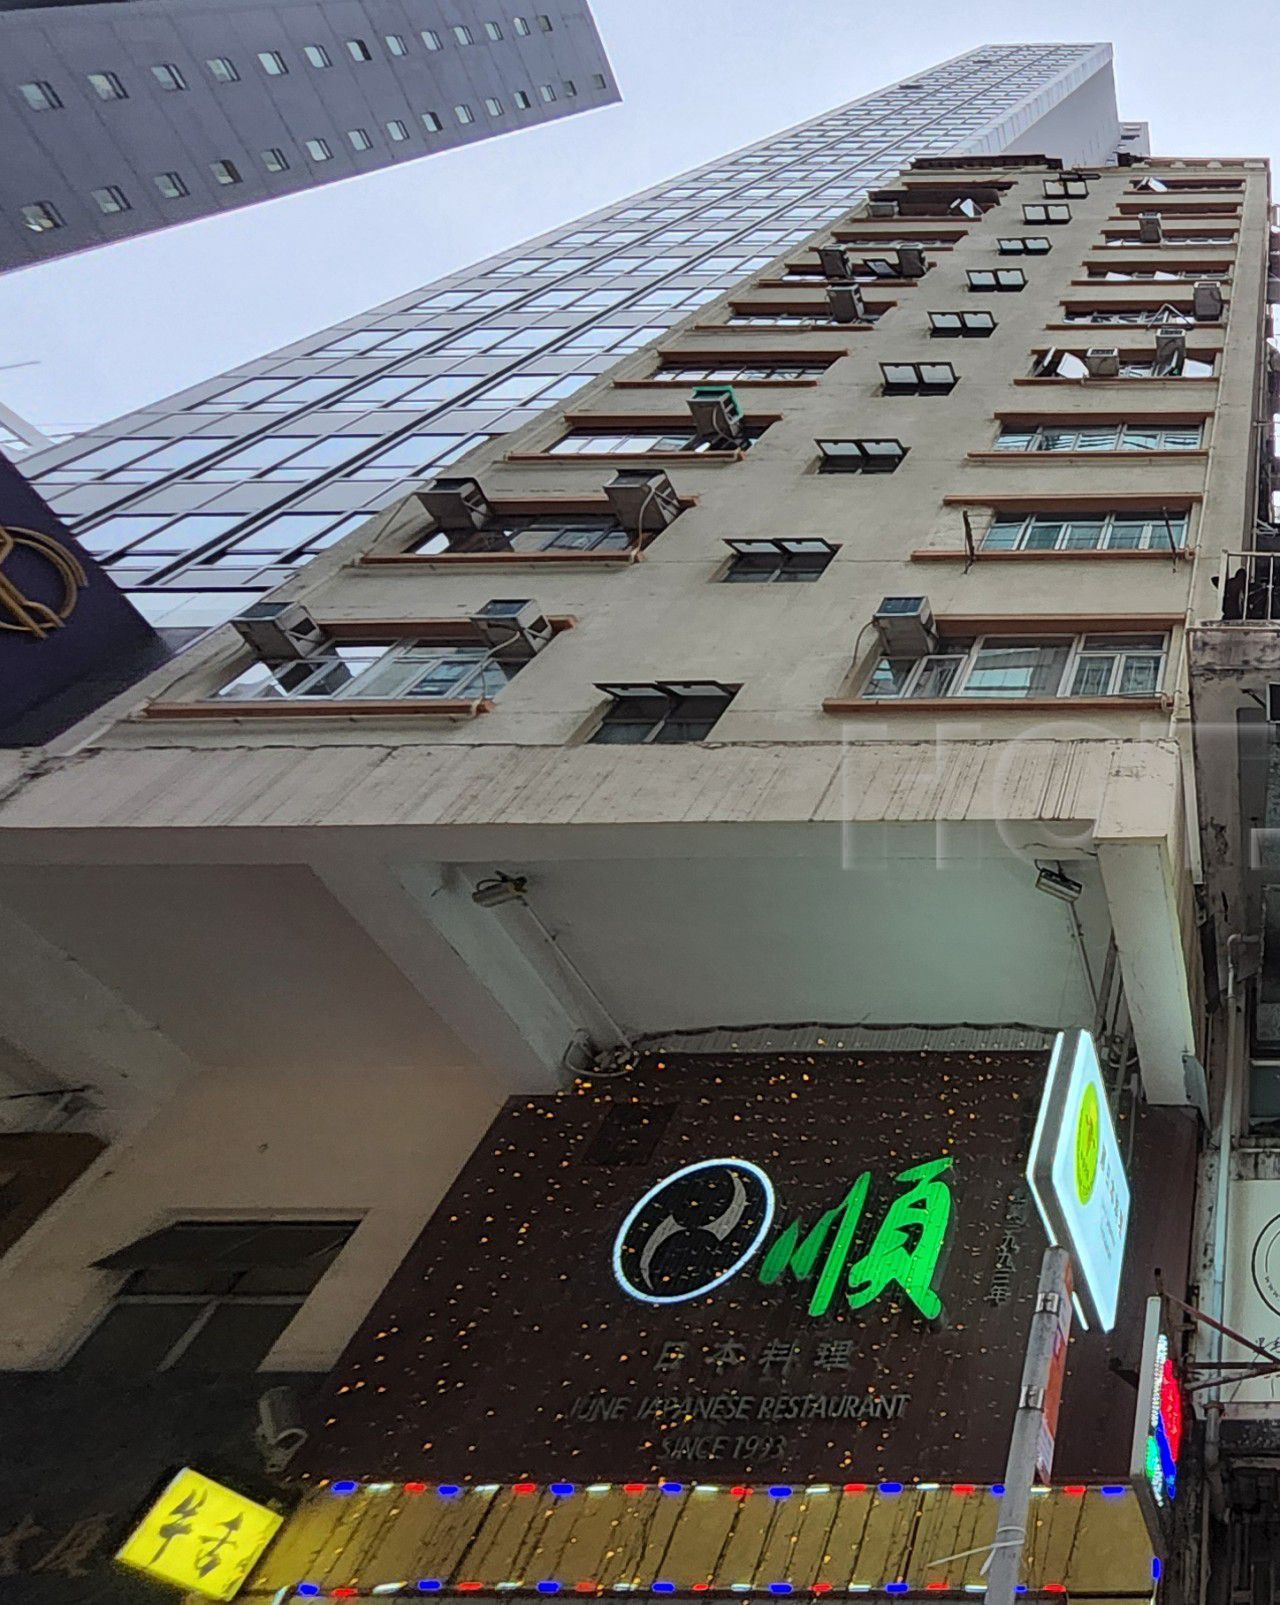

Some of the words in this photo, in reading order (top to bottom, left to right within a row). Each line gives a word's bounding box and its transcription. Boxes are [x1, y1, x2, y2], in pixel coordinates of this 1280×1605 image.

[757, 1156, 957, 1319] 順
[653, 1338, 860, 1376] 日本料理
[569, 1396, 632, 1421] JUNE
[637, 1394, 756, 1421] JAPANESE
[758, 1393, 912, 1420] RESTAURANT
[659, 1435, 726, 1460] SINCE
[732, 1435, 788, 1460] 1993
